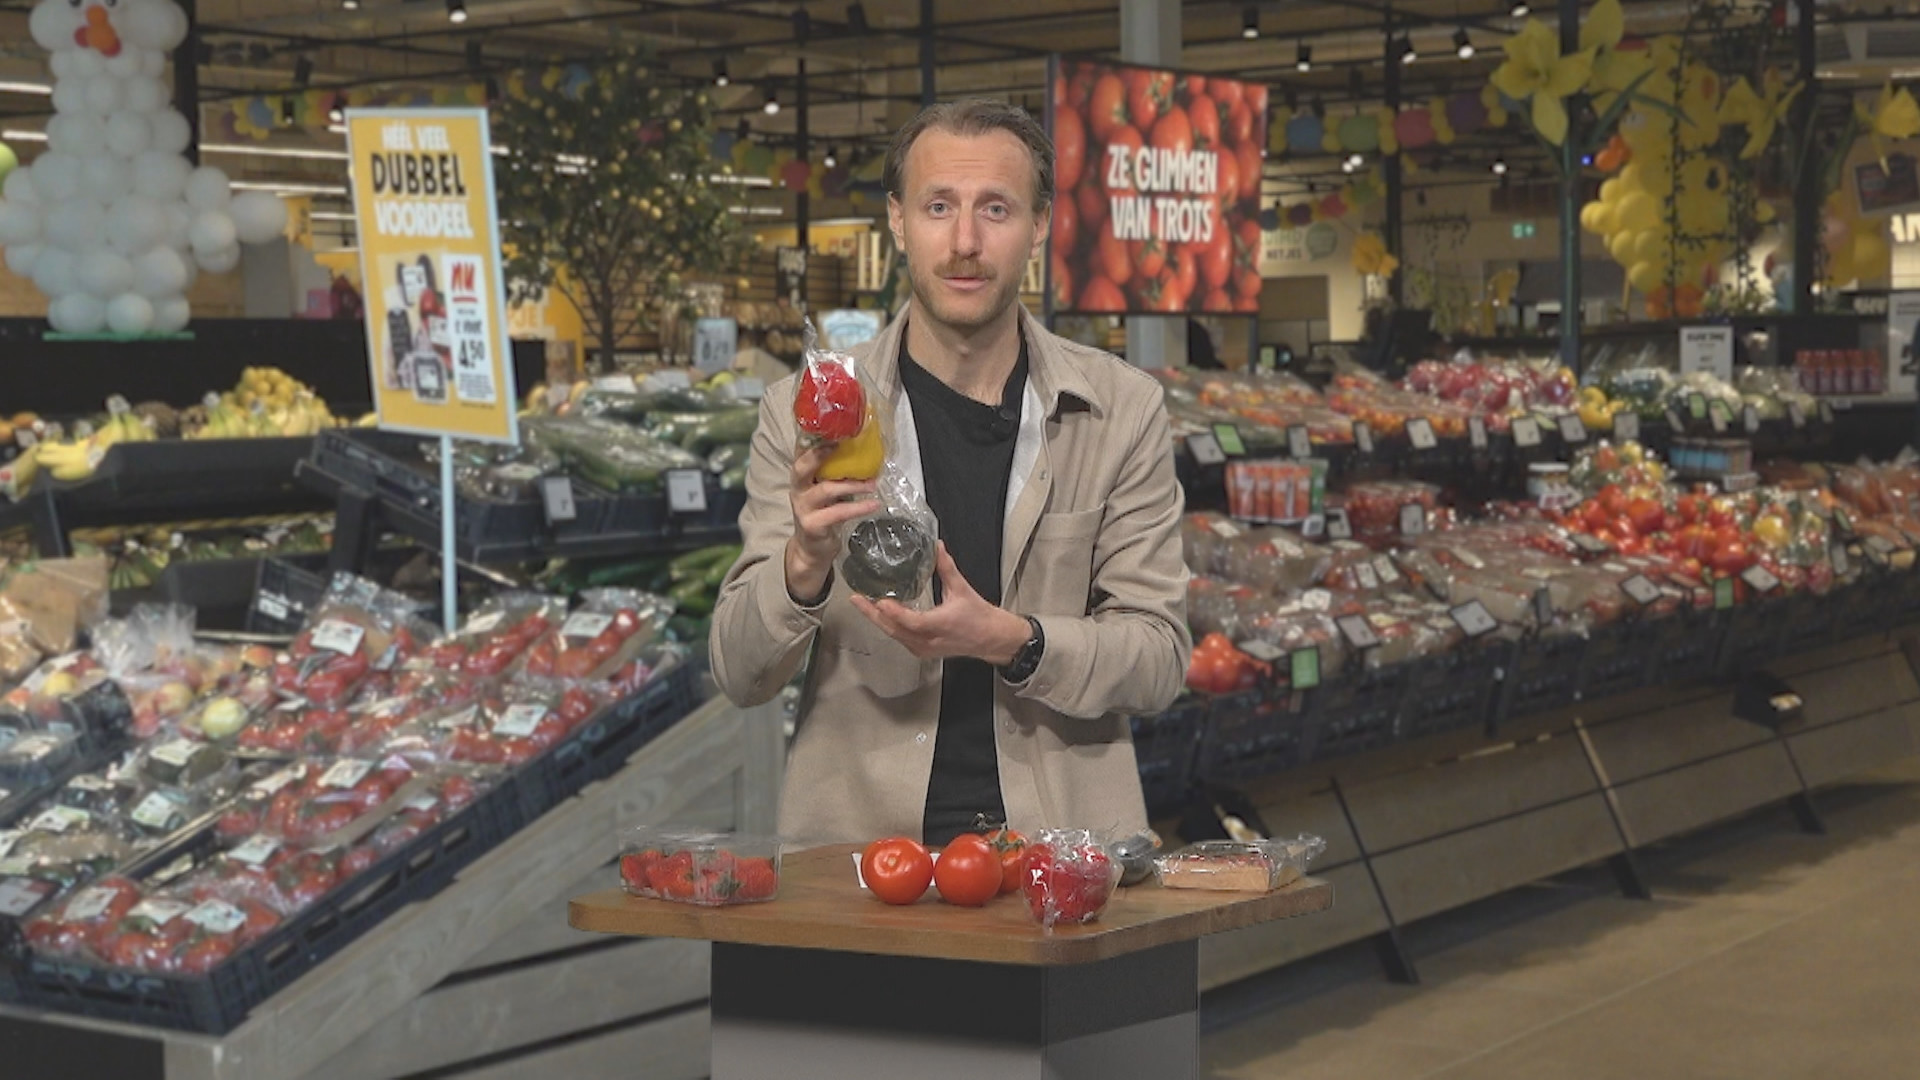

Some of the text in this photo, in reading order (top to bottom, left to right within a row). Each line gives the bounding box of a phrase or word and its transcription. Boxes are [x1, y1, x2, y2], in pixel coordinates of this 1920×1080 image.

[416, 125, 450, 150] VEEL
[371, 153, 466, 196] DUBBEL
[1108, 145, 1217, 192] ZE GLIMMEN
[375, 201, 474, 238] VOORDEEL
[1111, 195, 1213, 242] VAN TROTS
